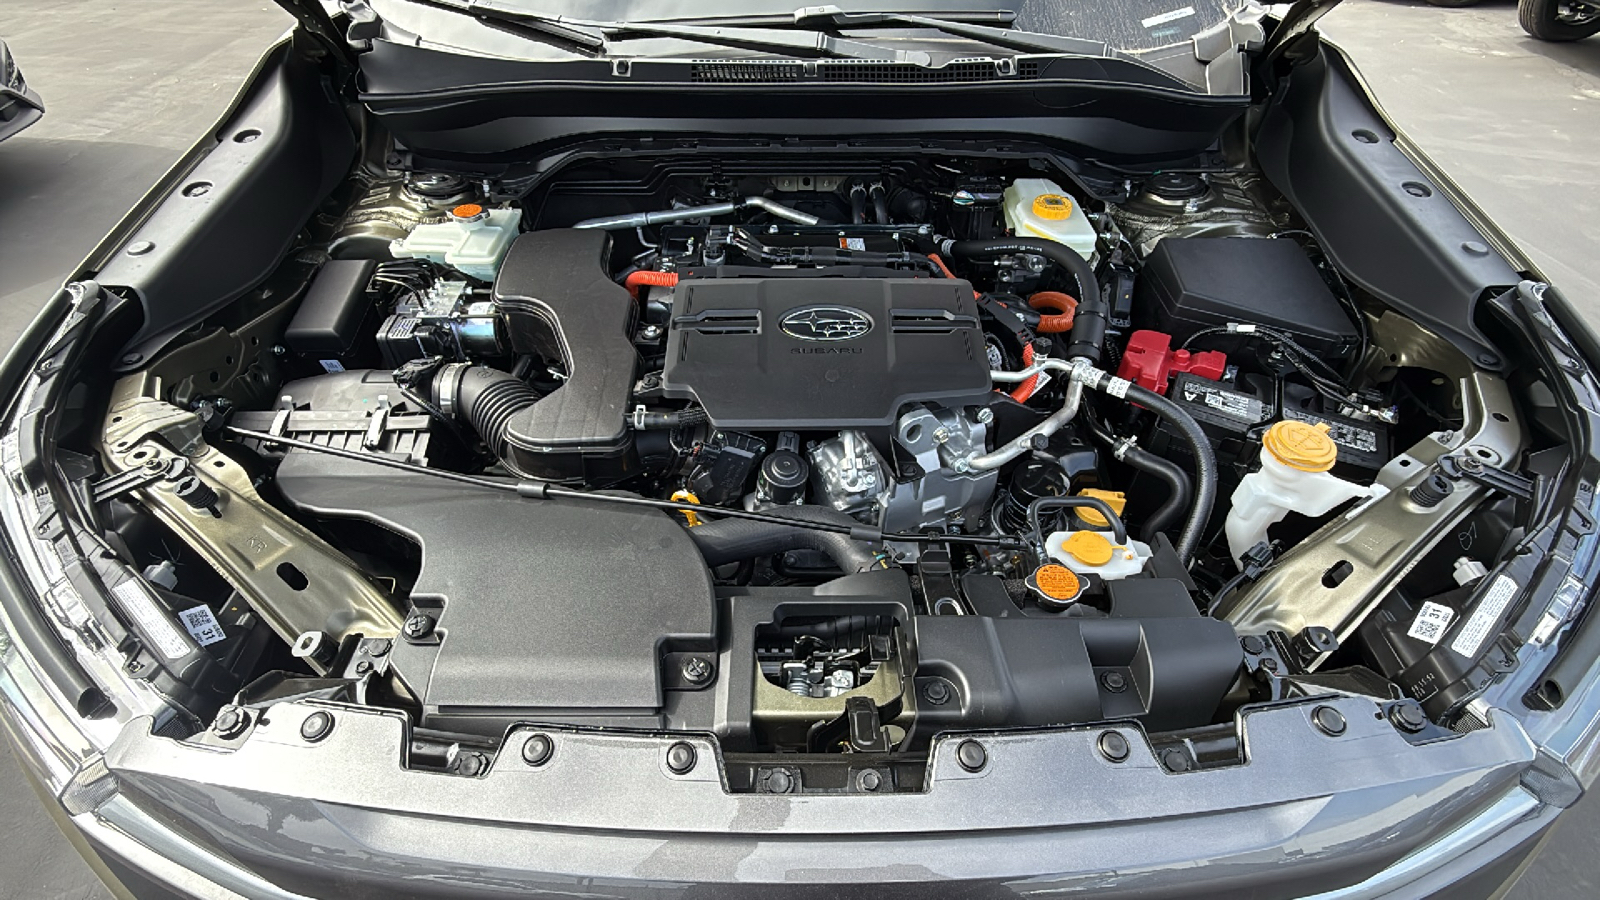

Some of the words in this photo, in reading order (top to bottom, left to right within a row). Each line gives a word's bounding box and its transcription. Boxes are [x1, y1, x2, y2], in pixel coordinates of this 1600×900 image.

[790, 347, 863, 355] SUBARU
[1429, 608, 1442, 620] 31
[201, 628, 215, 641] 31
